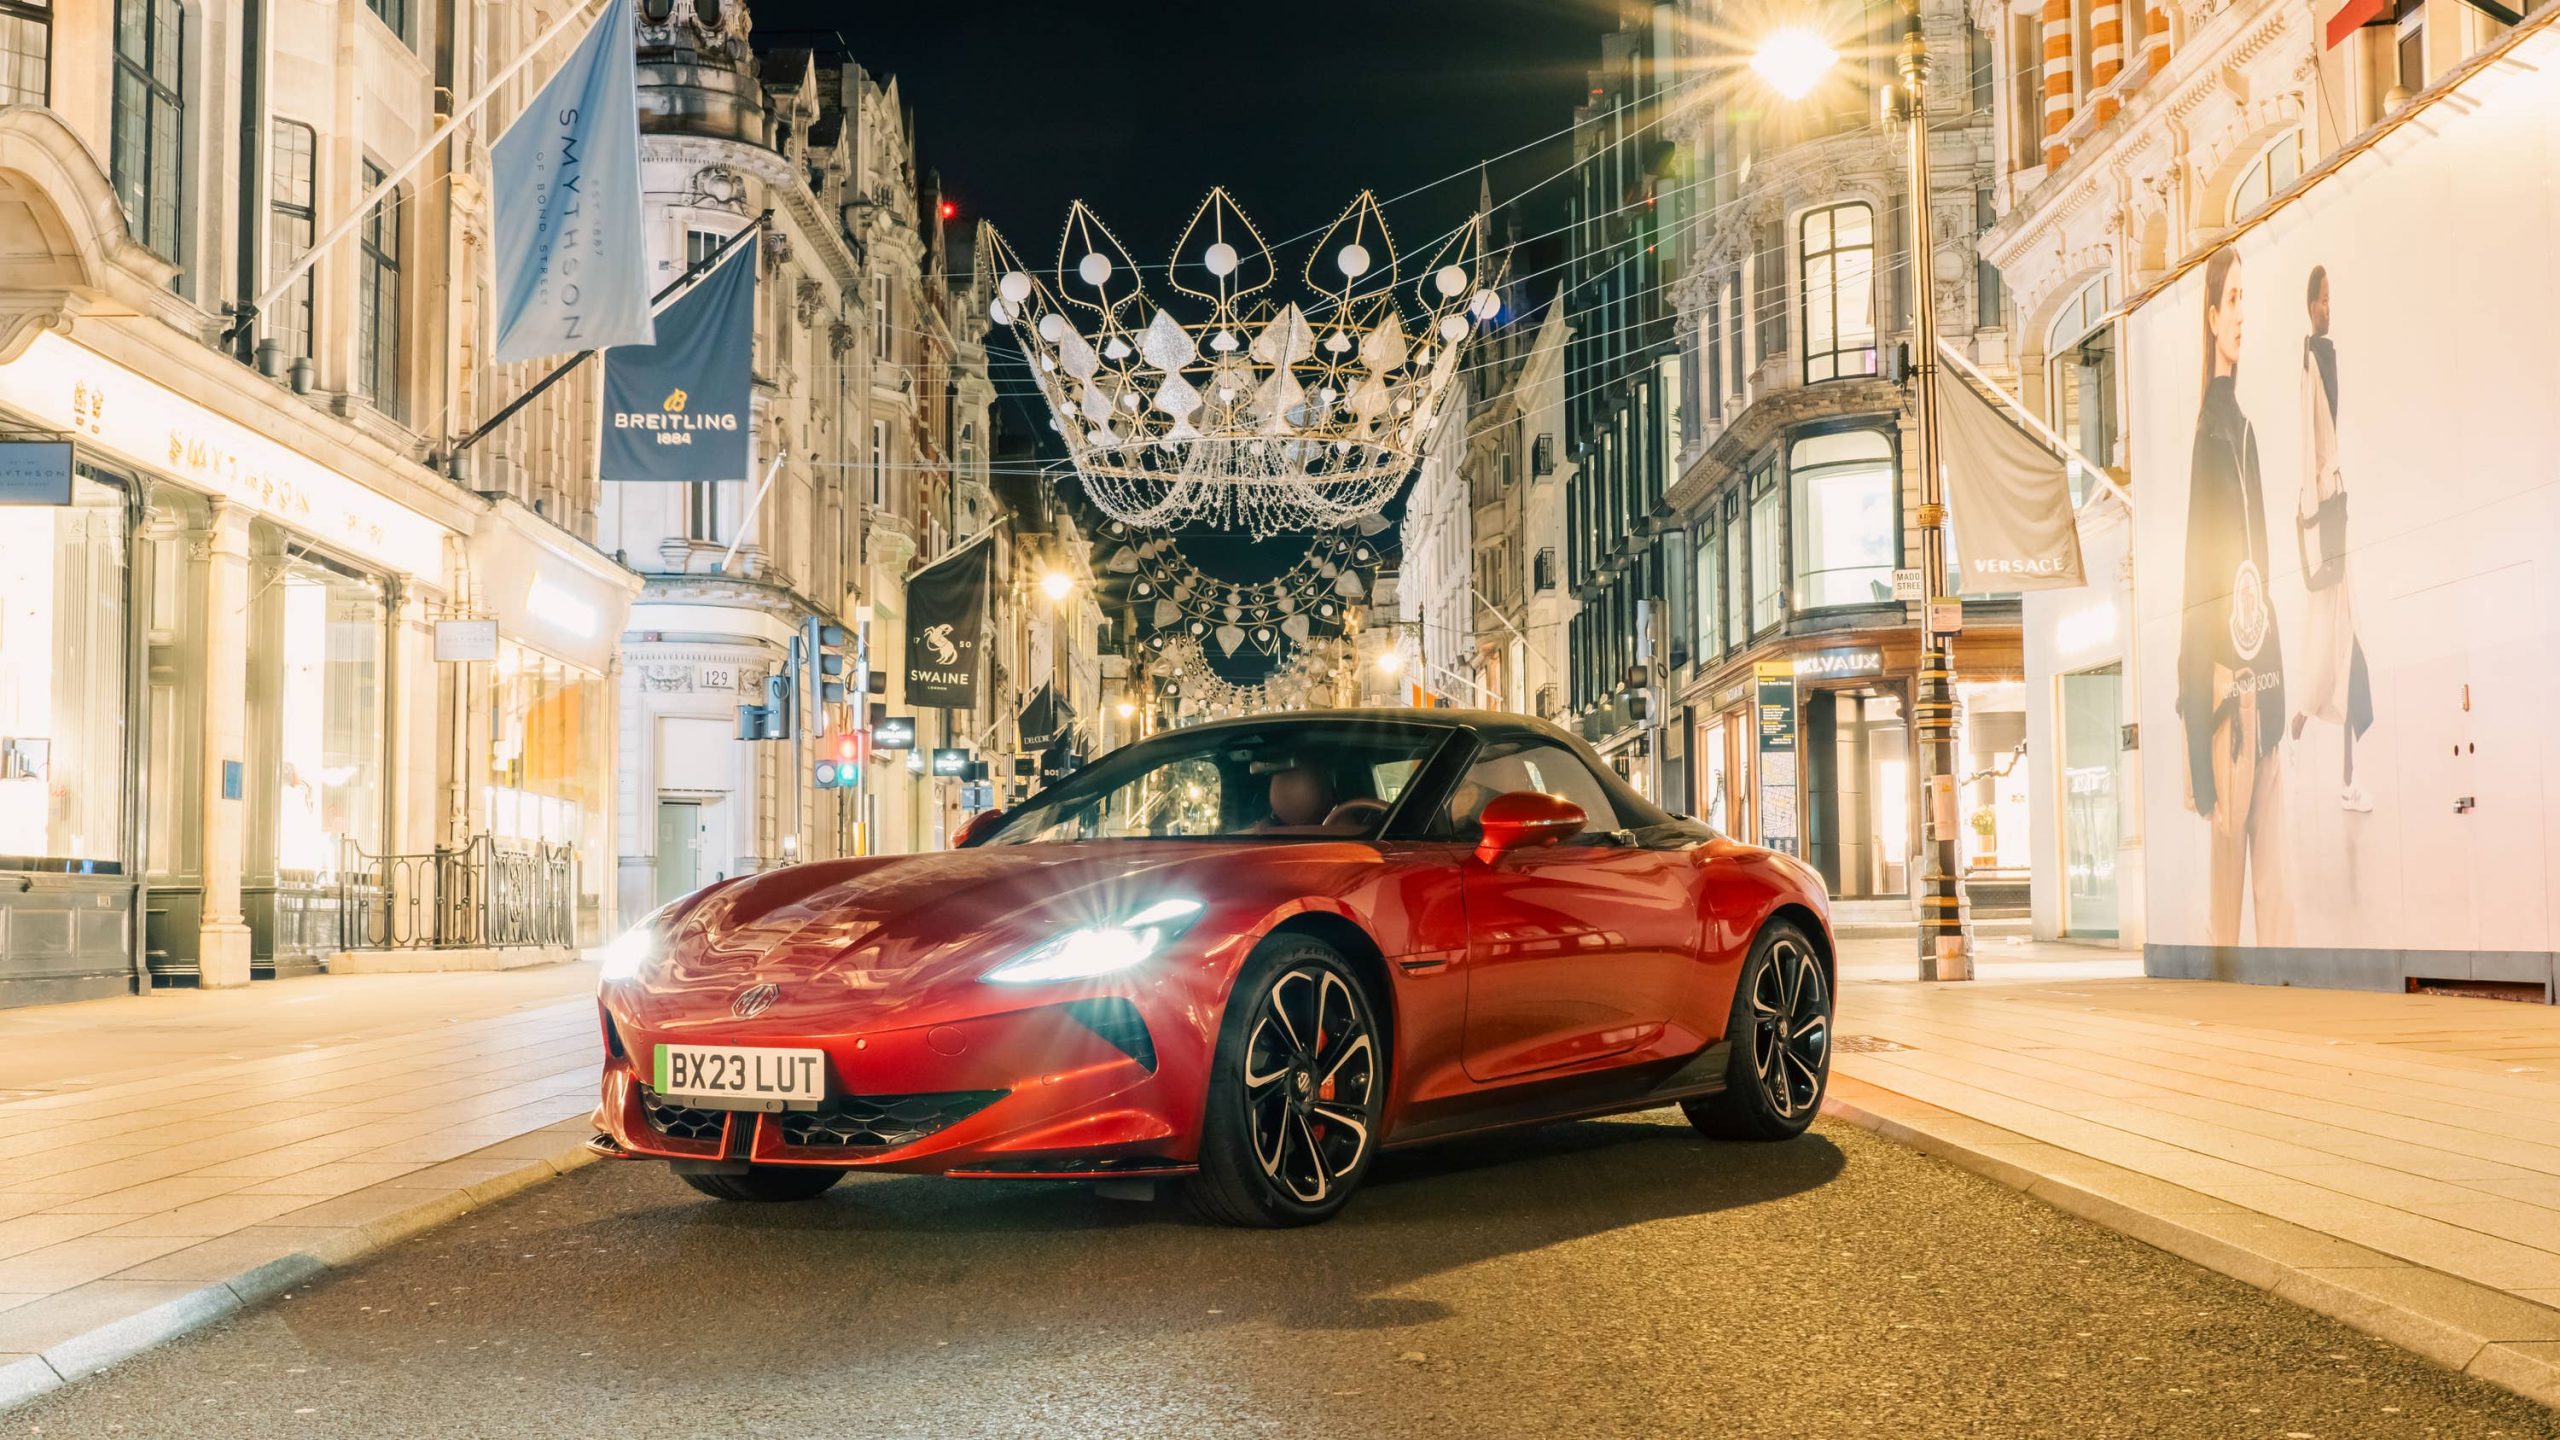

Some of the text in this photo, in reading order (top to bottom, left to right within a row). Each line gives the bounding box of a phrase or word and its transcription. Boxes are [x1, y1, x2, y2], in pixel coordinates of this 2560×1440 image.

[536, 152, 549, 305] OF BOND STREET
[559, 108, 583, 340] SMYTHSON
[614, 412, 738, 431] BREITLING
[657, 432, 692, 445] 1884
[1974, 557, 2064, 574] VERSACE
[1896, 572, 1920, 581] MADD
[1896, 582, 1921, 590] STREE
[959, 640, 972, 648] 50
[910, 669, 969, 685] SWAINE
[2223, 670, 2280, 700] OPENING SOON
[733, 984, 780, 1019] MG
[671, 1052, 817, 1094] BX23 LUT
